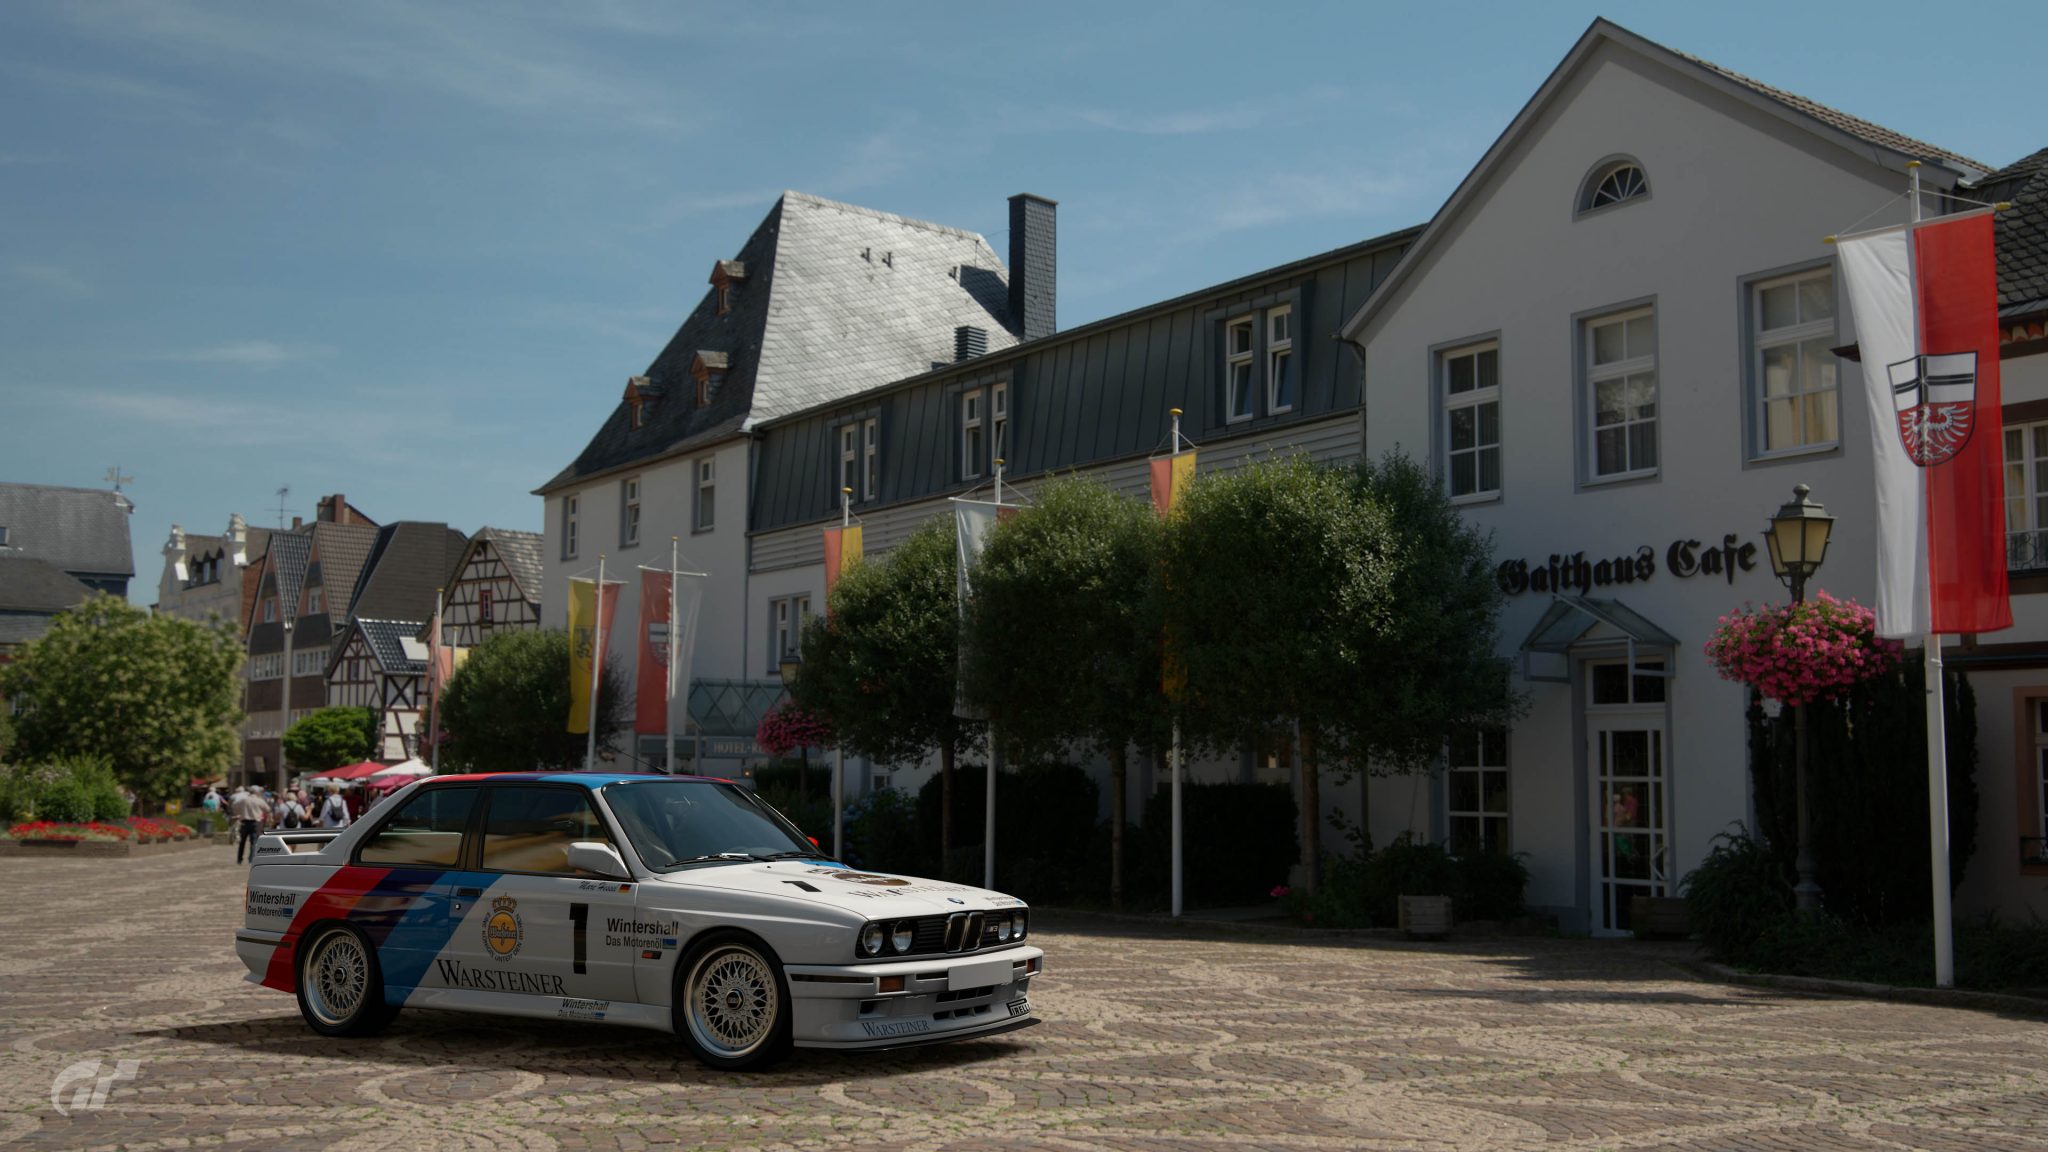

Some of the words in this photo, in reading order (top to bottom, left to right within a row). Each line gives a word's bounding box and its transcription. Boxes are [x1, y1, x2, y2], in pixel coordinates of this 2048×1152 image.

[1667, 534, 1757, 585] Cafe
[250, 891, 296, 905] Wintershall
[248, 905, 257, 915] Das
[607, 918, 679, 936] Wintershall
[569, 903, 588, 975] 1
[606, 935, 621, 946] Das
[623, 936, 662, 950] Motorenöl
[437, 959, 568, 996] WARSTEINER
[562, 998, 610, 1011] Wintershall
[862, 1020, 931, 1037] WARSTEINER
